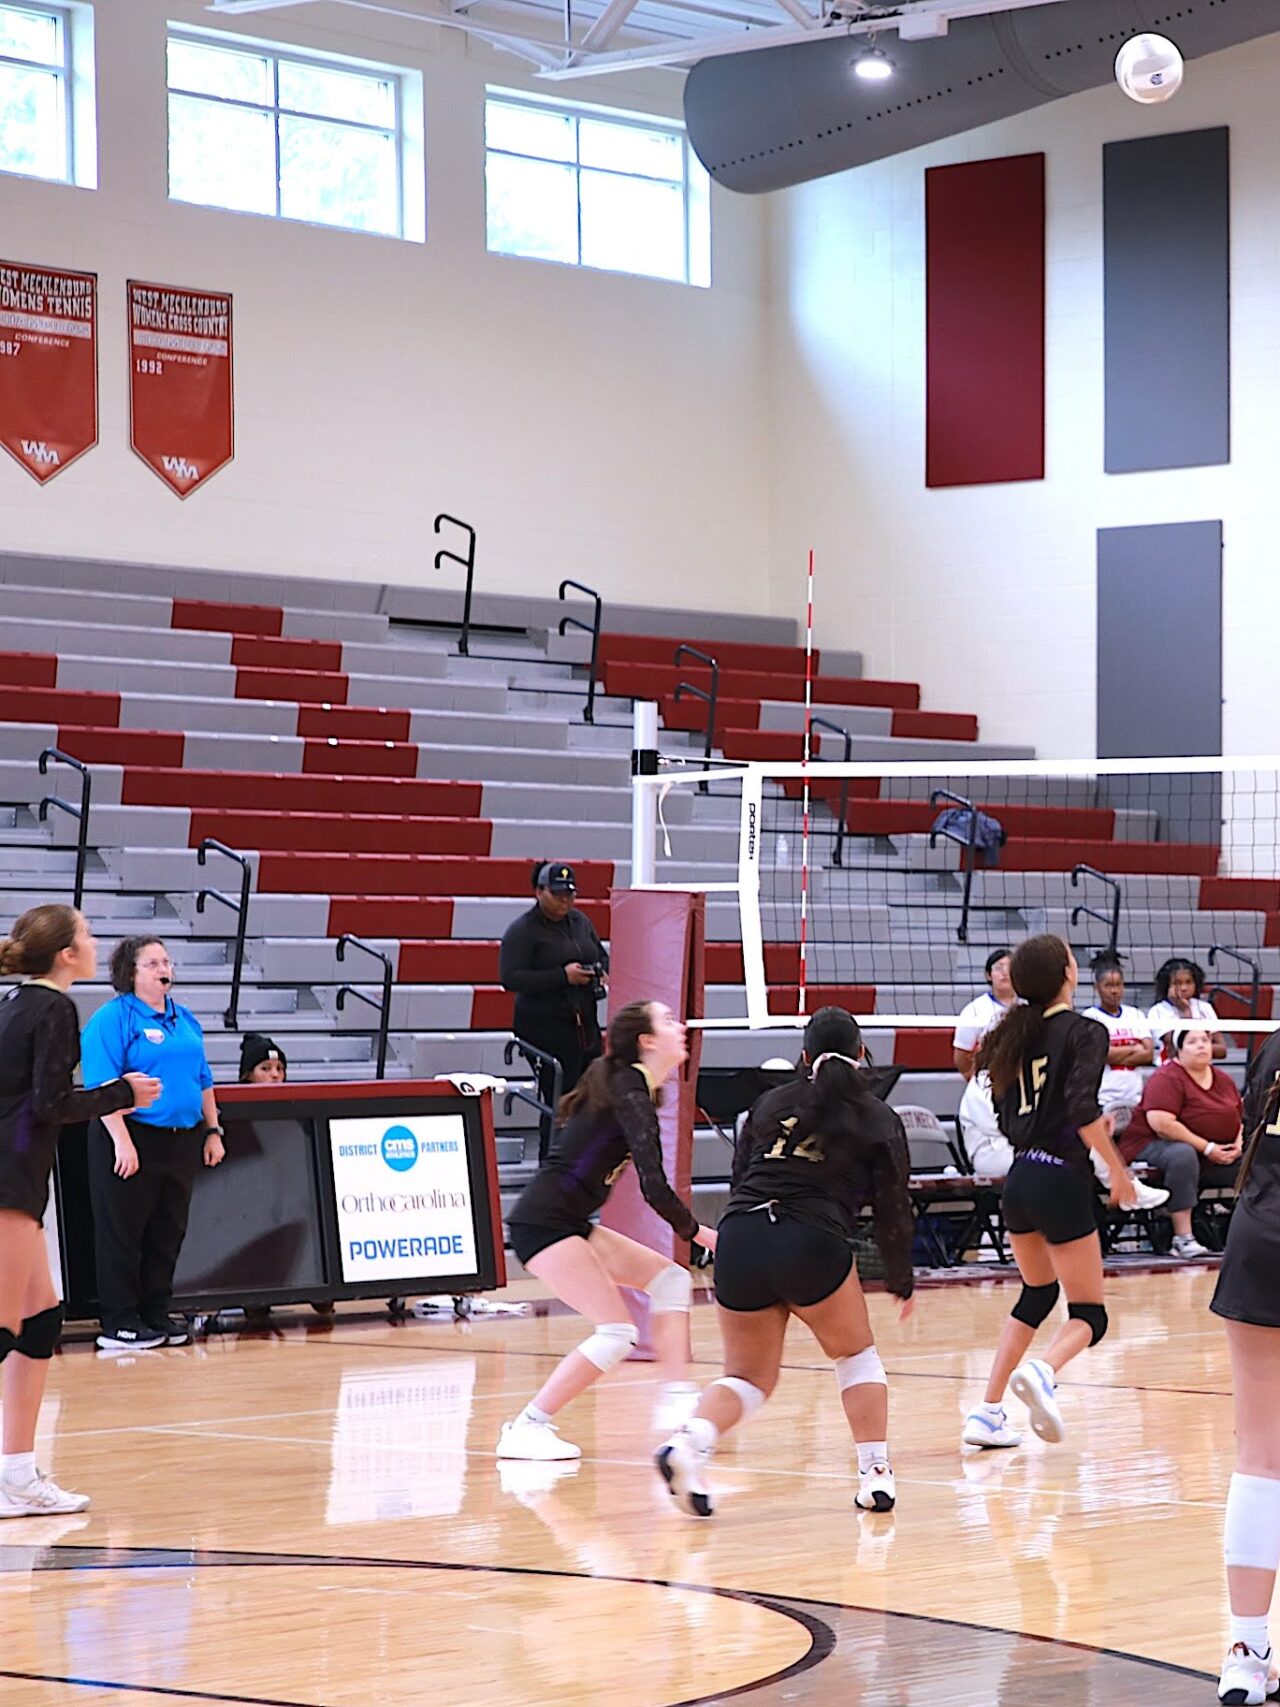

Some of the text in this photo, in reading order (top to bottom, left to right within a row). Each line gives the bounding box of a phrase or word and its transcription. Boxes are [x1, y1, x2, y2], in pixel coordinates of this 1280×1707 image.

[0, 268, 92, 297] EST MECKLENBURG
[0, 285, 92, 319] OMENS TENNIS
[132, 287, 228, 316] WEST MECKLENBURG
[132, 301, 228, 337] WOMENS CROSS COUNTRY
[0, 340, 21, 356] 987
[15, 333, 70, 347] CONFERENCE
[136, 358, 163, 375] 1992
[156, 351, 208, 366] CONFERENCE
[339, 1144, 378, 1157] DISTRICT
[420, 1140, 459, 1154] PARTNERS
[341, 1188, 466, 1214] OrthoCarolina
[350, 1235, 464, 1261] POWERADE
